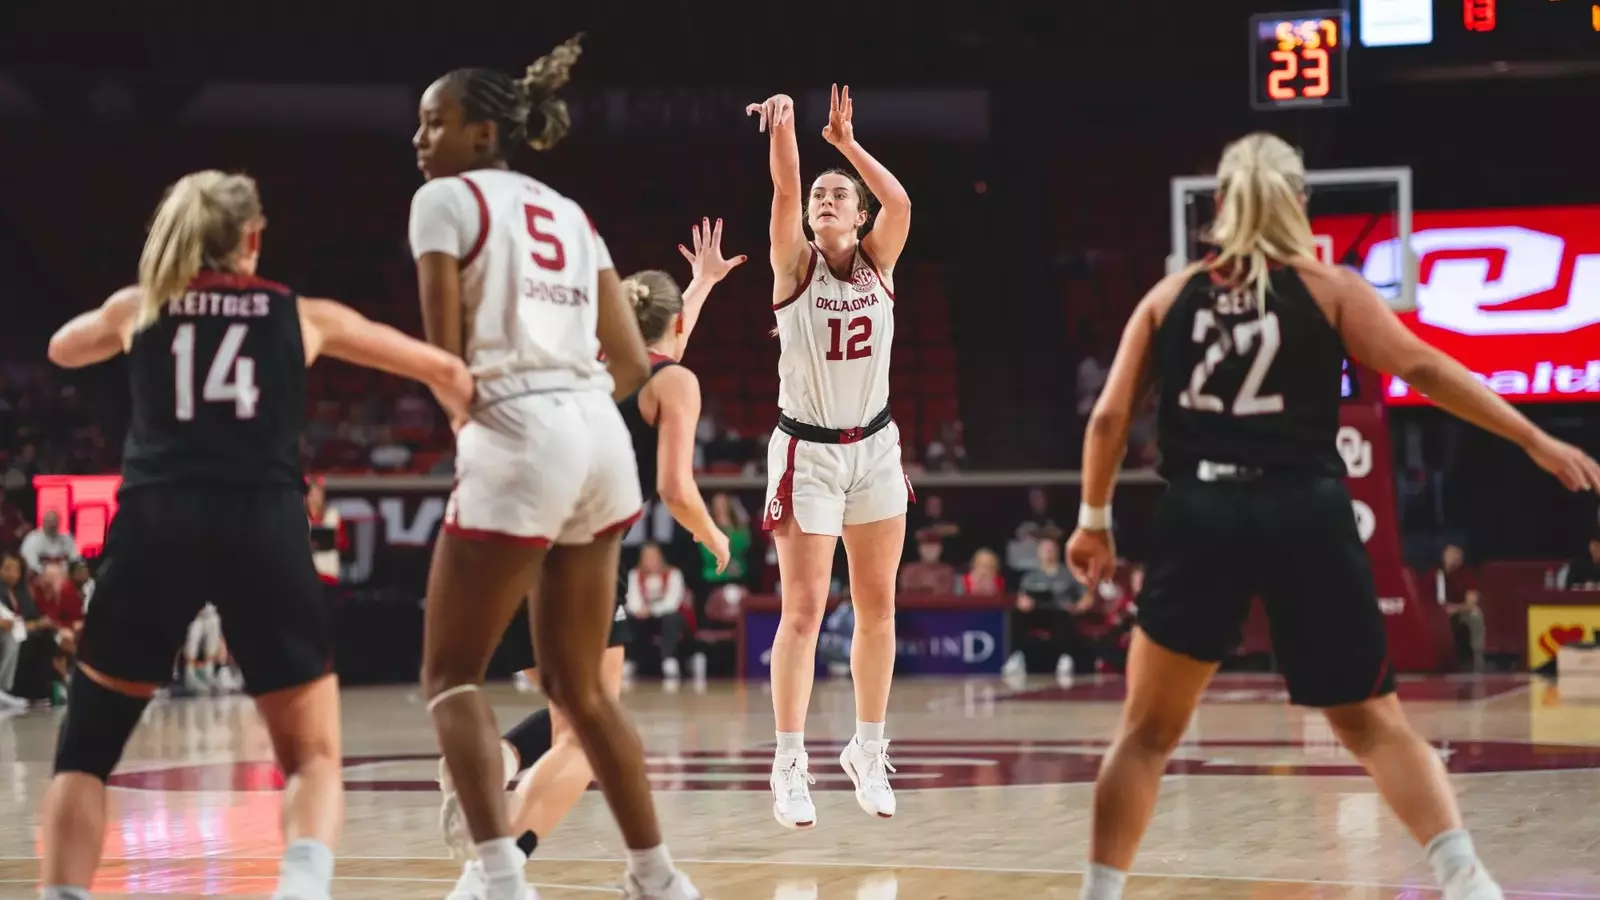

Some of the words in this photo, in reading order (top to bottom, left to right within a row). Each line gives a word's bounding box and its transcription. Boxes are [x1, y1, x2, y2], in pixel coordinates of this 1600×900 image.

[1276, 20, 1337, 51] 5:57
[1268, 49, 1330, 100] 23
[524, 203, 566, 272] 5
[853, 268, 872, 286] SEC
[816, 293, 879, 312] OKLAOMA
[826, 316, 872, 361] 12
[171, 323, 260, 421] 14
[1179, 309, 1284, 416] 22
[769, 498, 783, 521] OU
